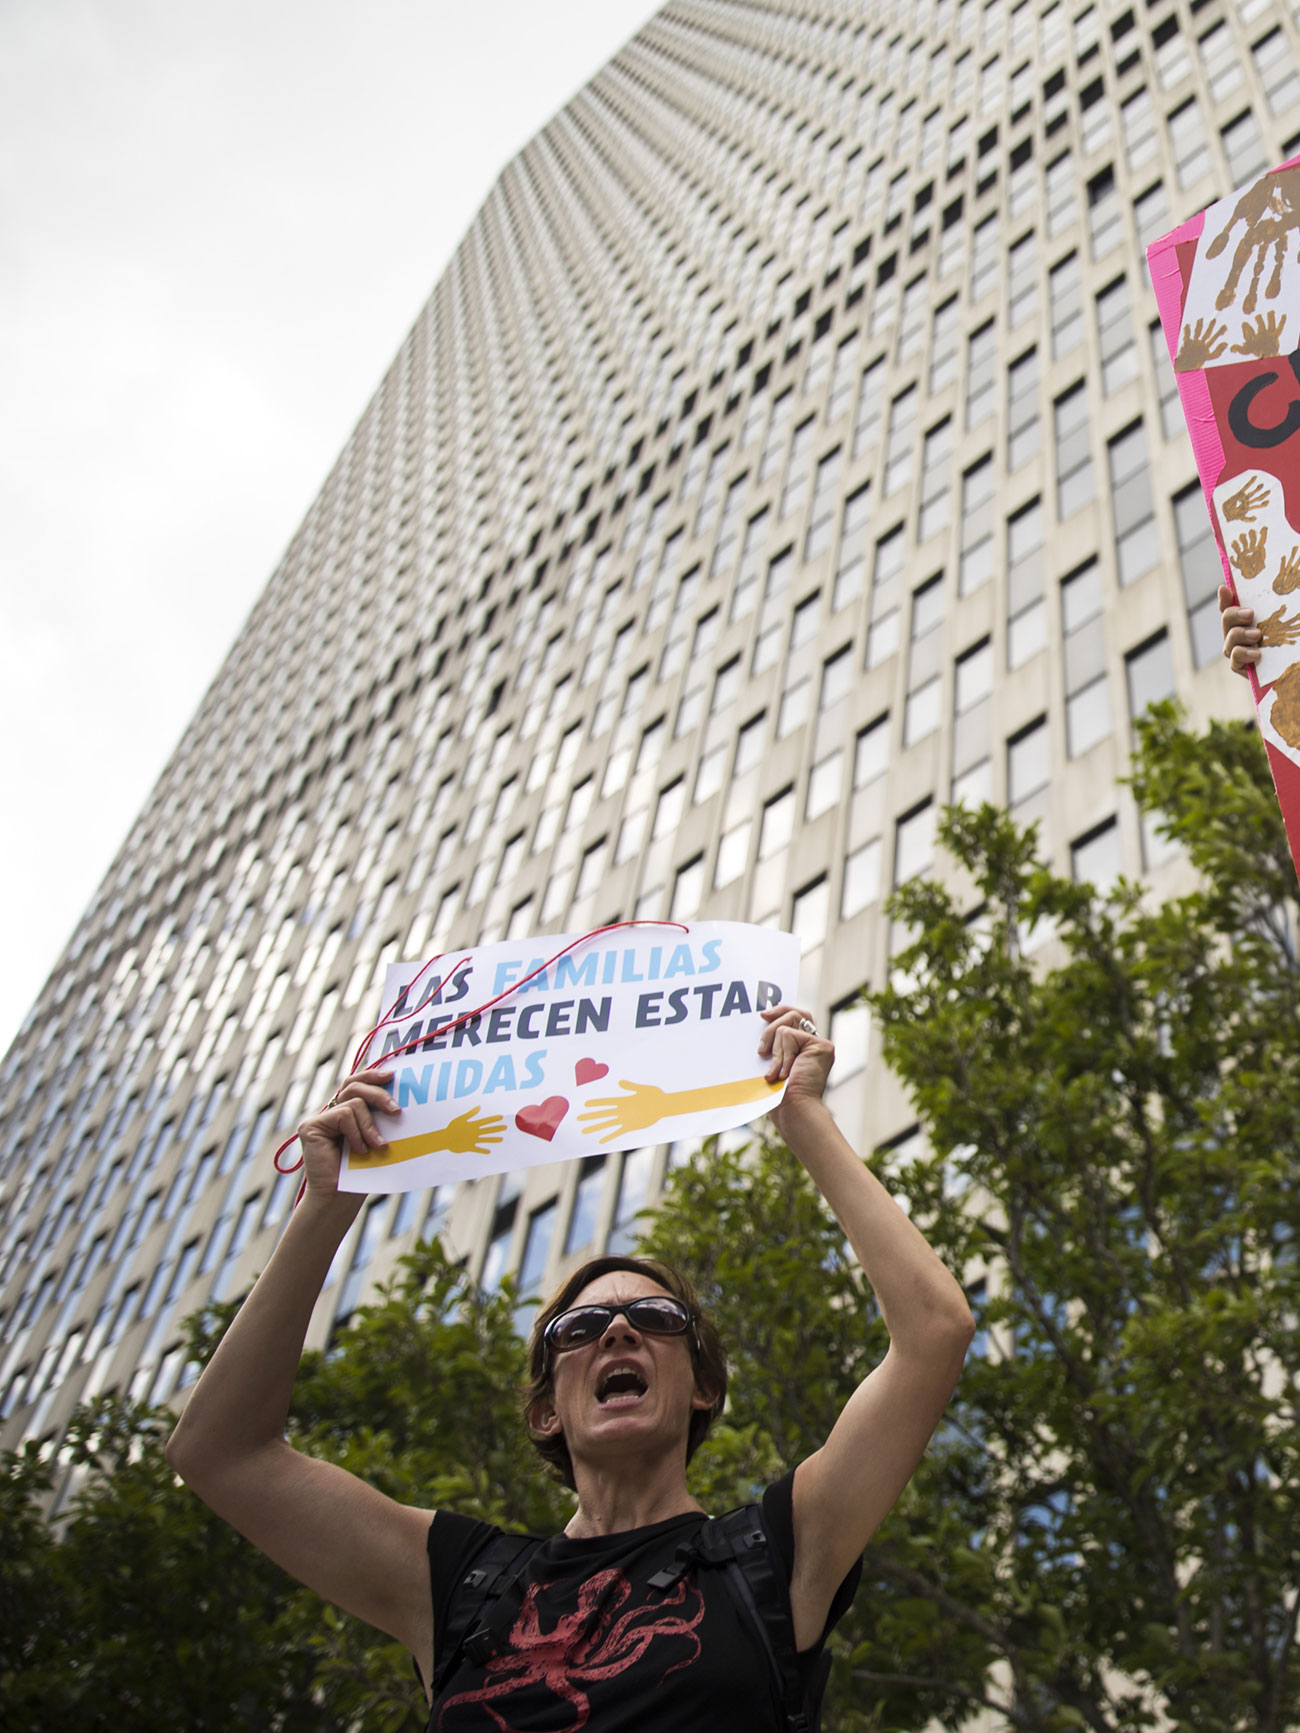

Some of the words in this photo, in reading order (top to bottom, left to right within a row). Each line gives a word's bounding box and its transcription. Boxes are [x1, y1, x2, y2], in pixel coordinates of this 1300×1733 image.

[392, 966, 474, 1019] LAS
[492, 939, 722, 996] FAMILIAS
[379, 995, 612, 1058] MERECEN
[635, 980, 782, 1029] ESTAR
